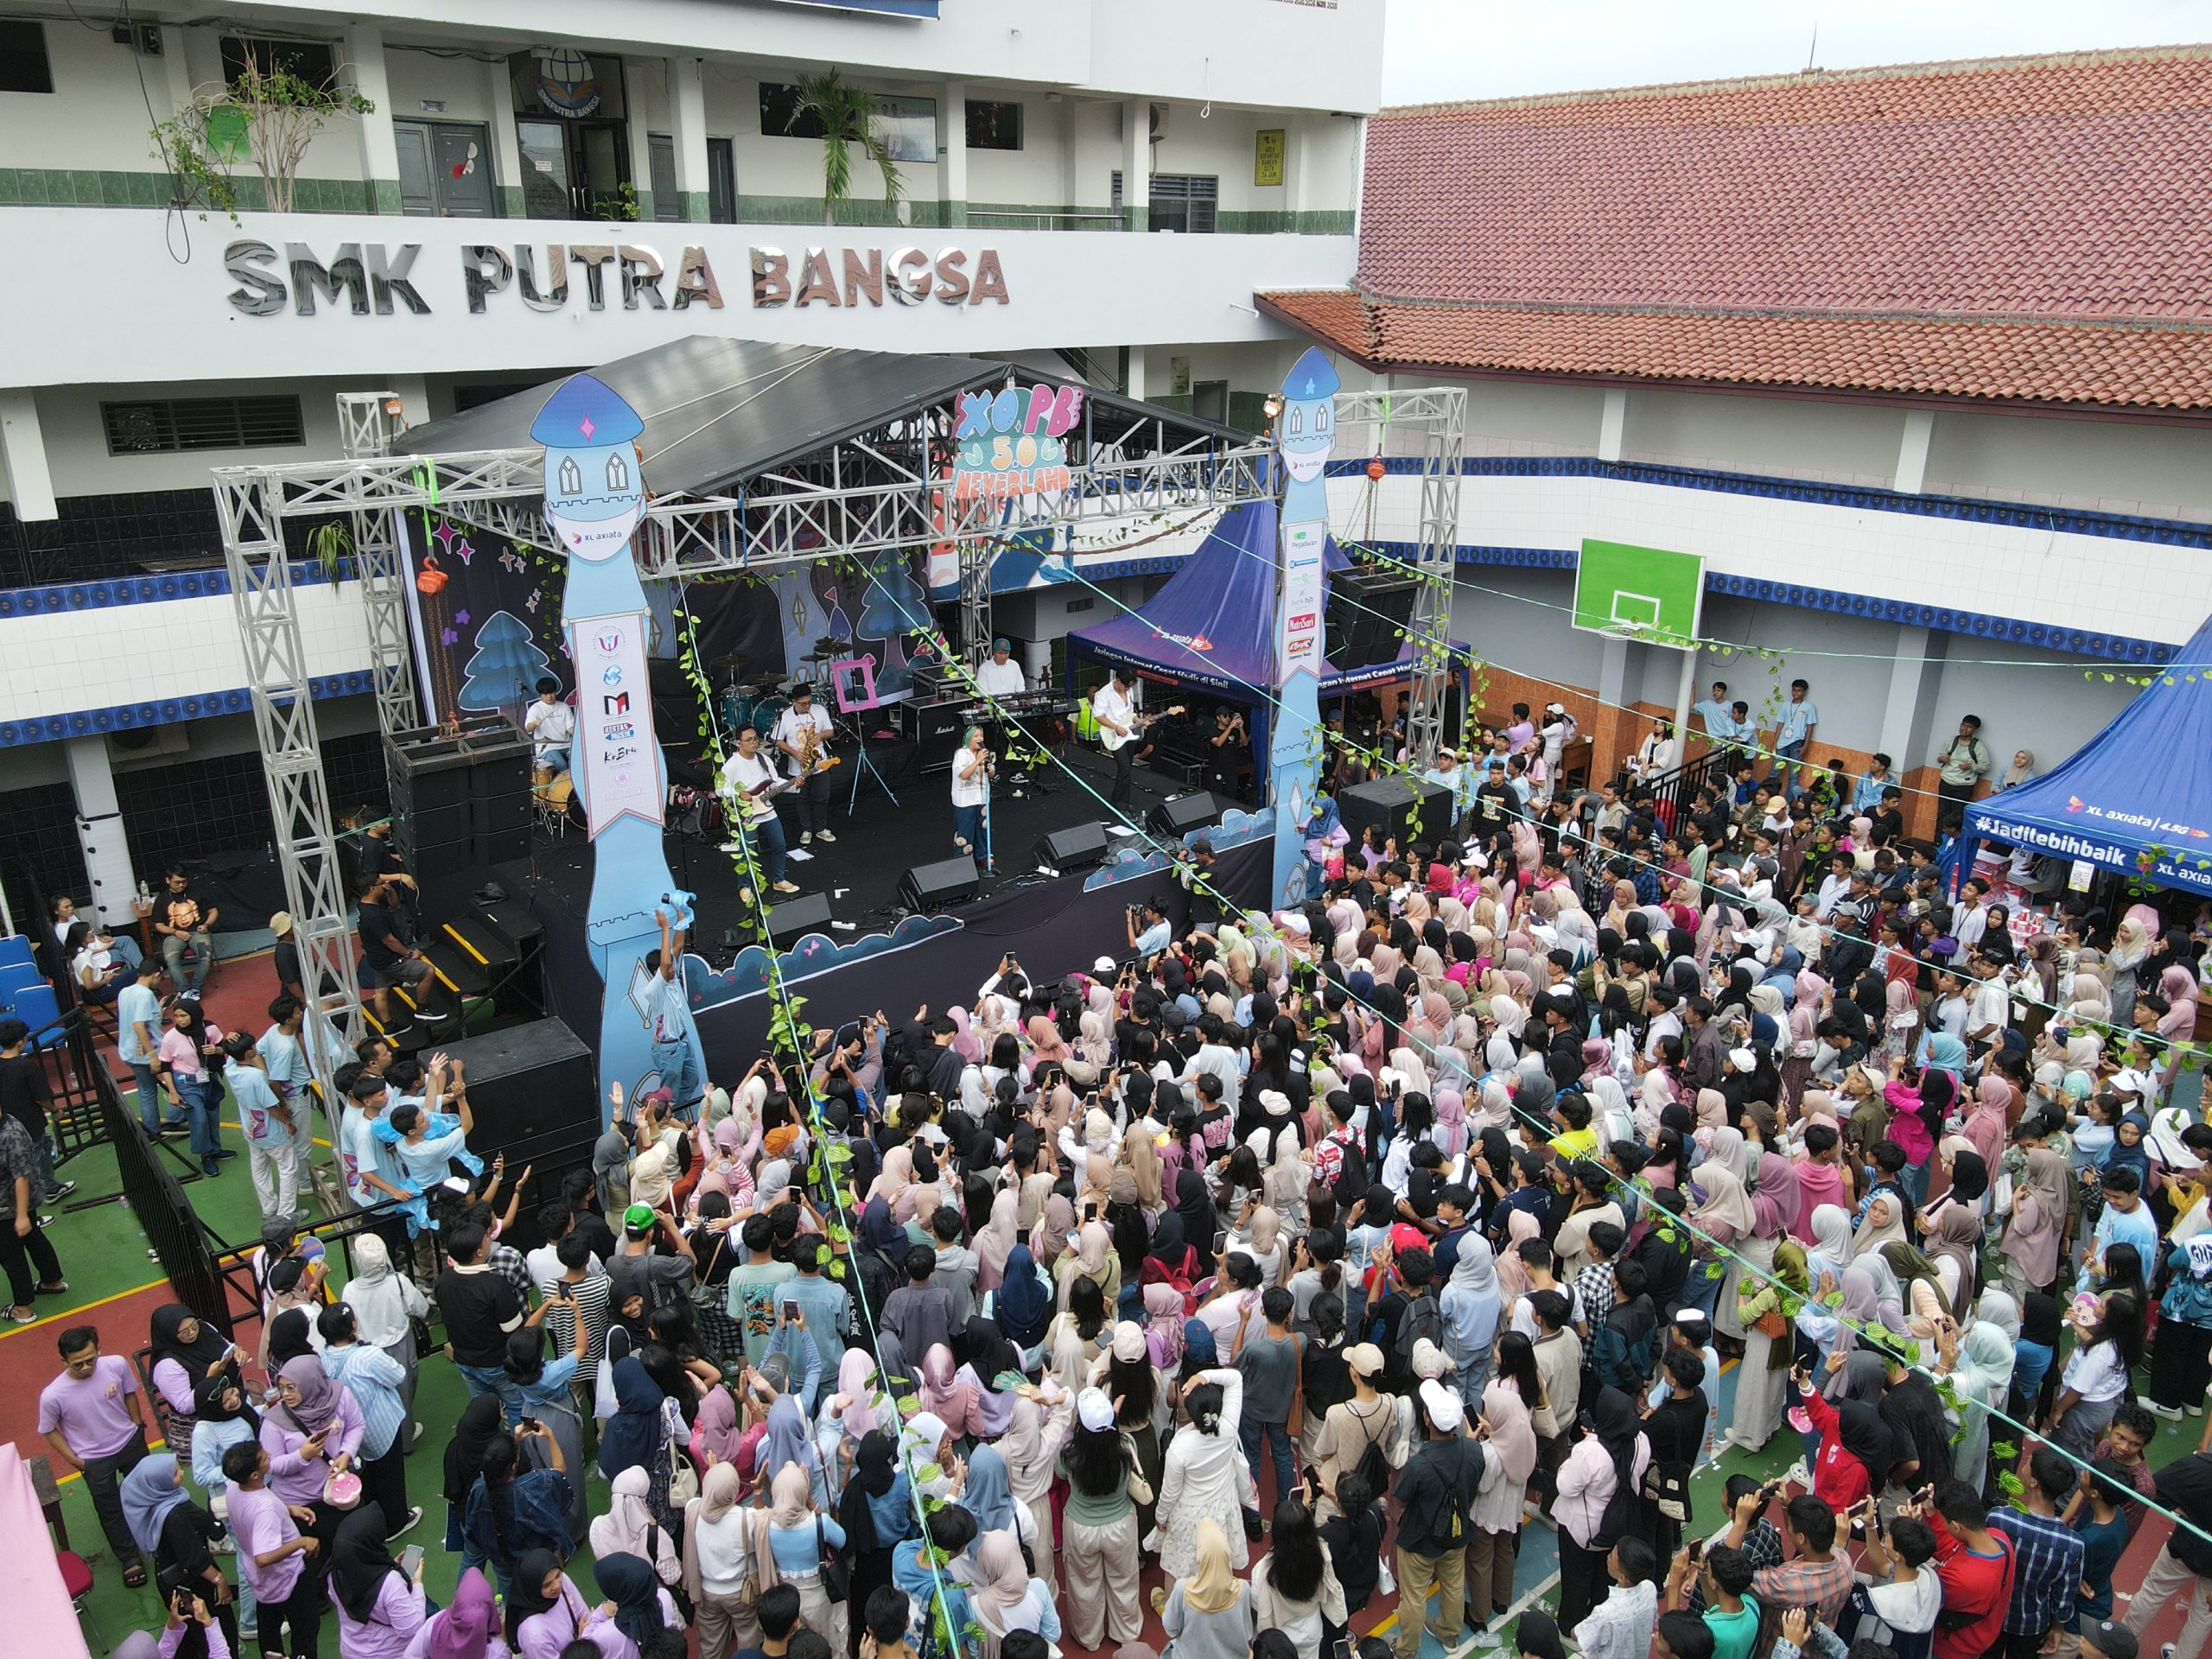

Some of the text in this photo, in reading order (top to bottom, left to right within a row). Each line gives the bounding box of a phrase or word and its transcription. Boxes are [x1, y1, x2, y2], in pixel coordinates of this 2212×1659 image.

[575, 95, 601, 118] BANGSA
[224, 238, 1009, 316] SMK PUTRA BANGSA
[991, 435, 1037, 470] 5.0
[953, 465, 1071, 500] NEVERLAND
[596, 531, 622, 540] axiata
[1292, 540, 1318, 549] Pegadaian
[1304, 596, 1314, 606] bjb
[1288, 616, 1315, 629] NutriSari
[1172, 633, 1192, 645] axiata
[1192, 639, 1205, 648] 5G
[1093, 645, 1122, 662] Jaringan
[1123, 655, 1153, 670] Internet
[1209, 678, 1229, 690] Sini!
[1373, 667, 1396, 678] Cepat
[2086, 804, 2191, 835] XL axiata 4.5G
[2157, 862, 2176, 877] XL
